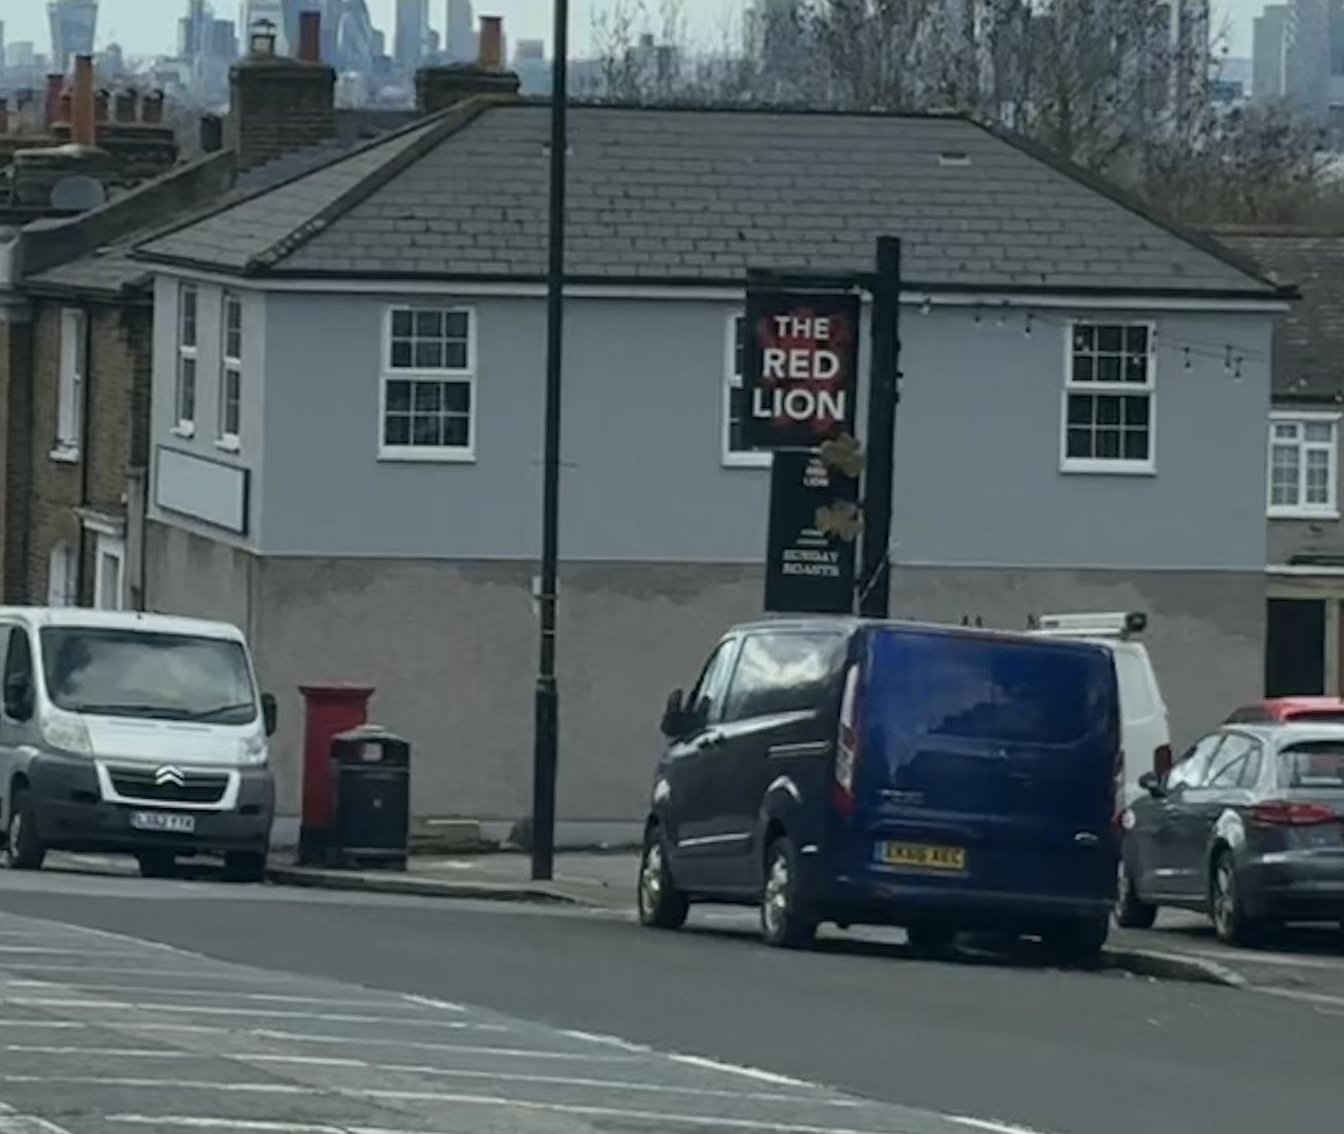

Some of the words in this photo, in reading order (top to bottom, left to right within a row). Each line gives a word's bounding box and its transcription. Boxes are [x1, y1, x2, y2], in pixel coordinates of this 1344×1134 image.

[773, 315, 830, 340] THE
[762, 348, 840, 379] RED
[752, 386, 846, 421] LION
